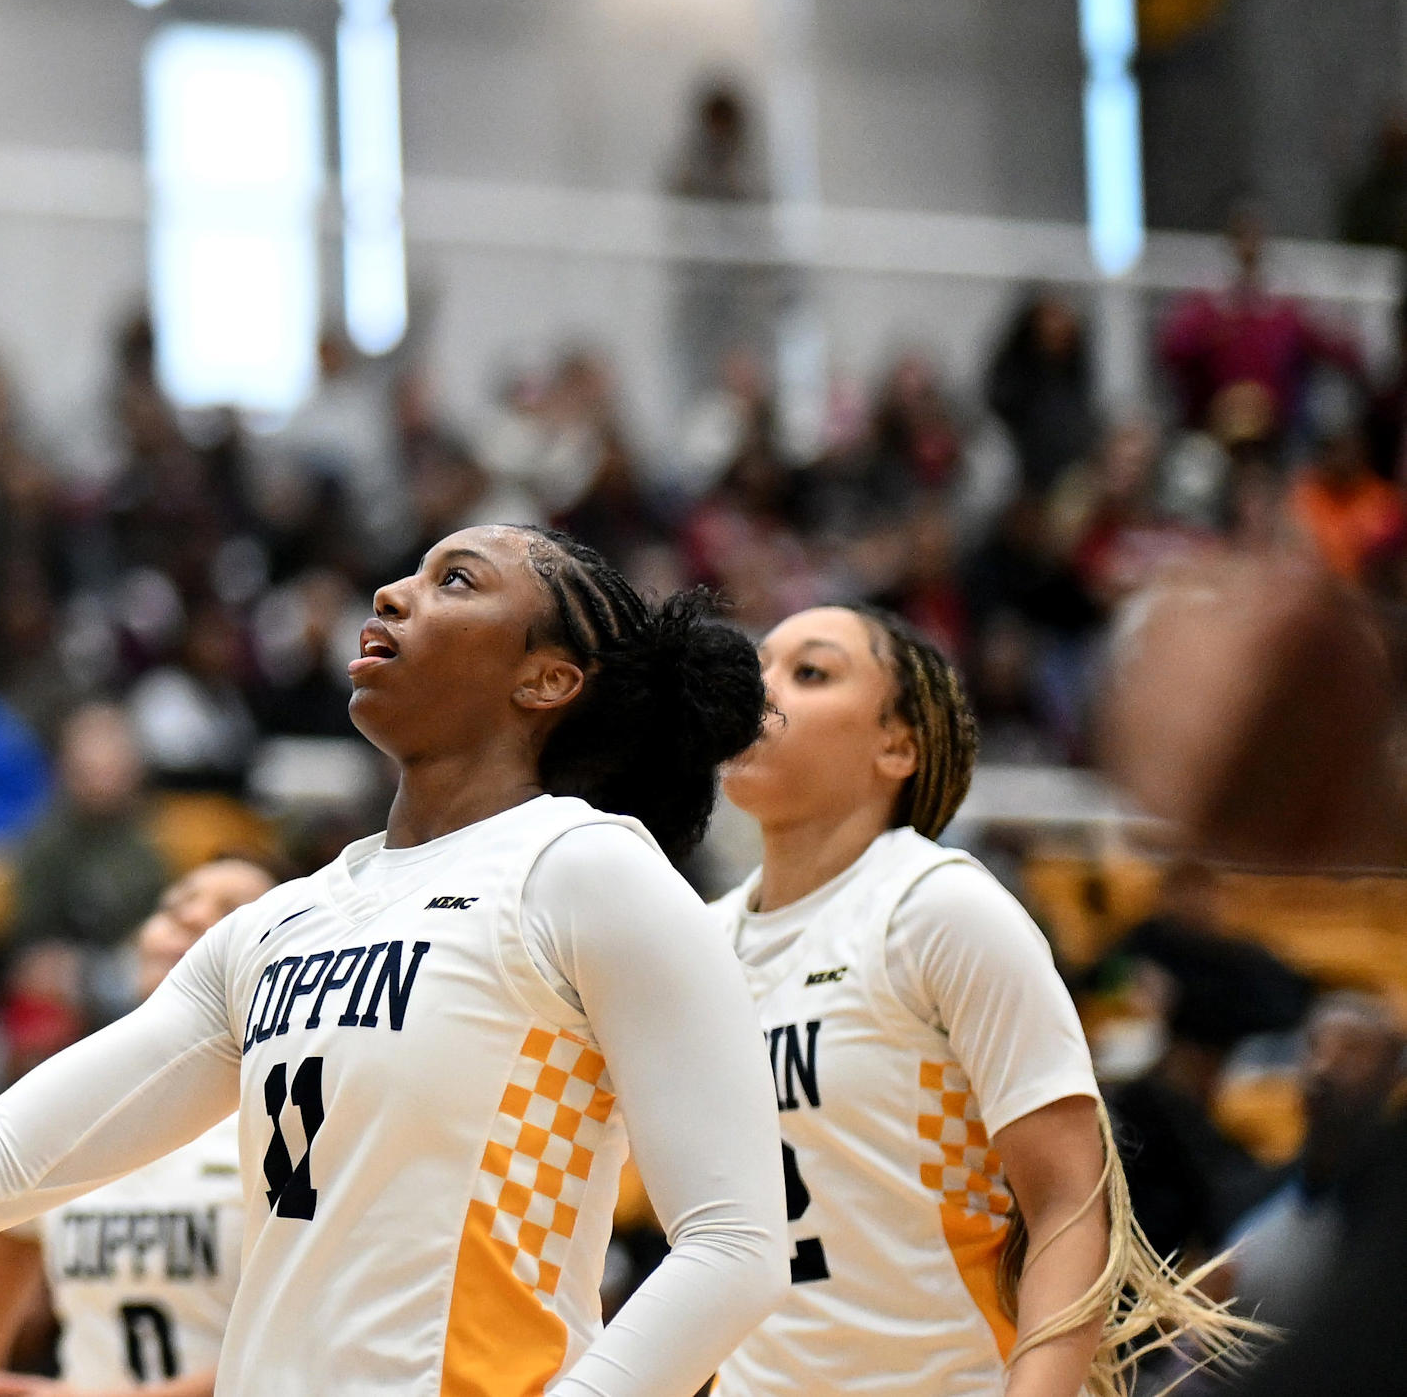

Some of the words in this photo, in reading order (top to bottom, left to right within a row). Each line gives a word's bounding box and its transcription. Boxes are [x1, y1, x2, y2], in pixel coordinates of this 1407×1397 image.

[423, 896, 480, 910] MEAC
[242, 940, 431, 1056] COPPIN
[764, 1020, 822, 1112] IN
[263, 1056, 325, 1222] 11
